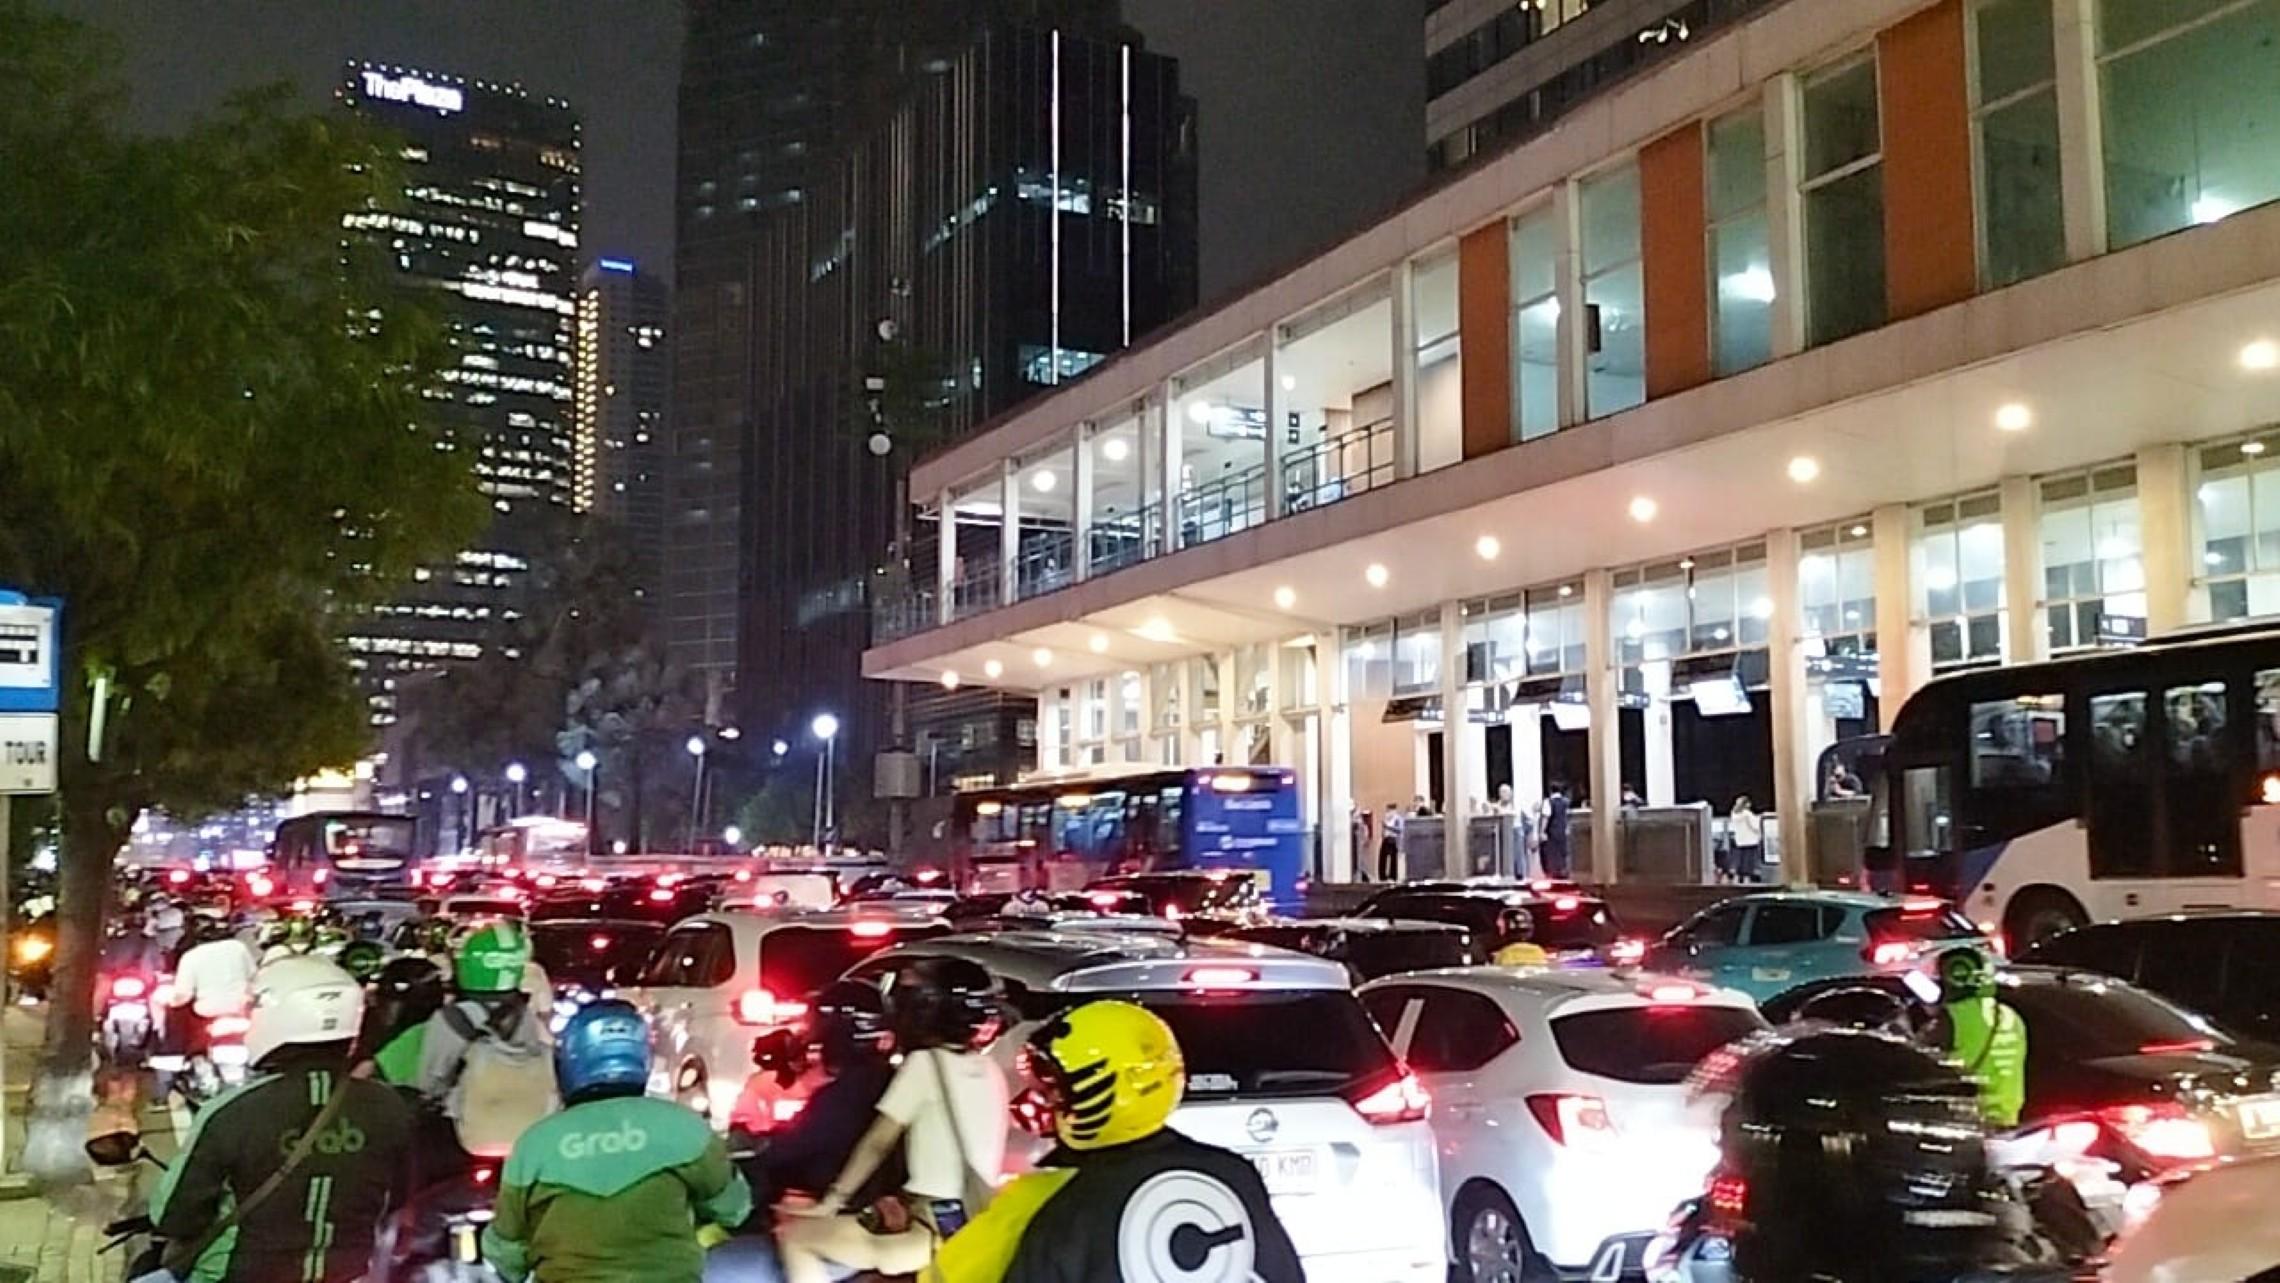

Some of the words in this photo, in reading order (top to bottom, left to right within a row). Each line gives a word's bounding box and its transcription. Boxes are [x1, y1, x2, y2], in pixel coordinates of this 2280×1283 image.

[5, 740, 46, 765] TOUR
[281, 1117, 366, 1155] Gab
[560, 1119, 648, 1159] Grab
